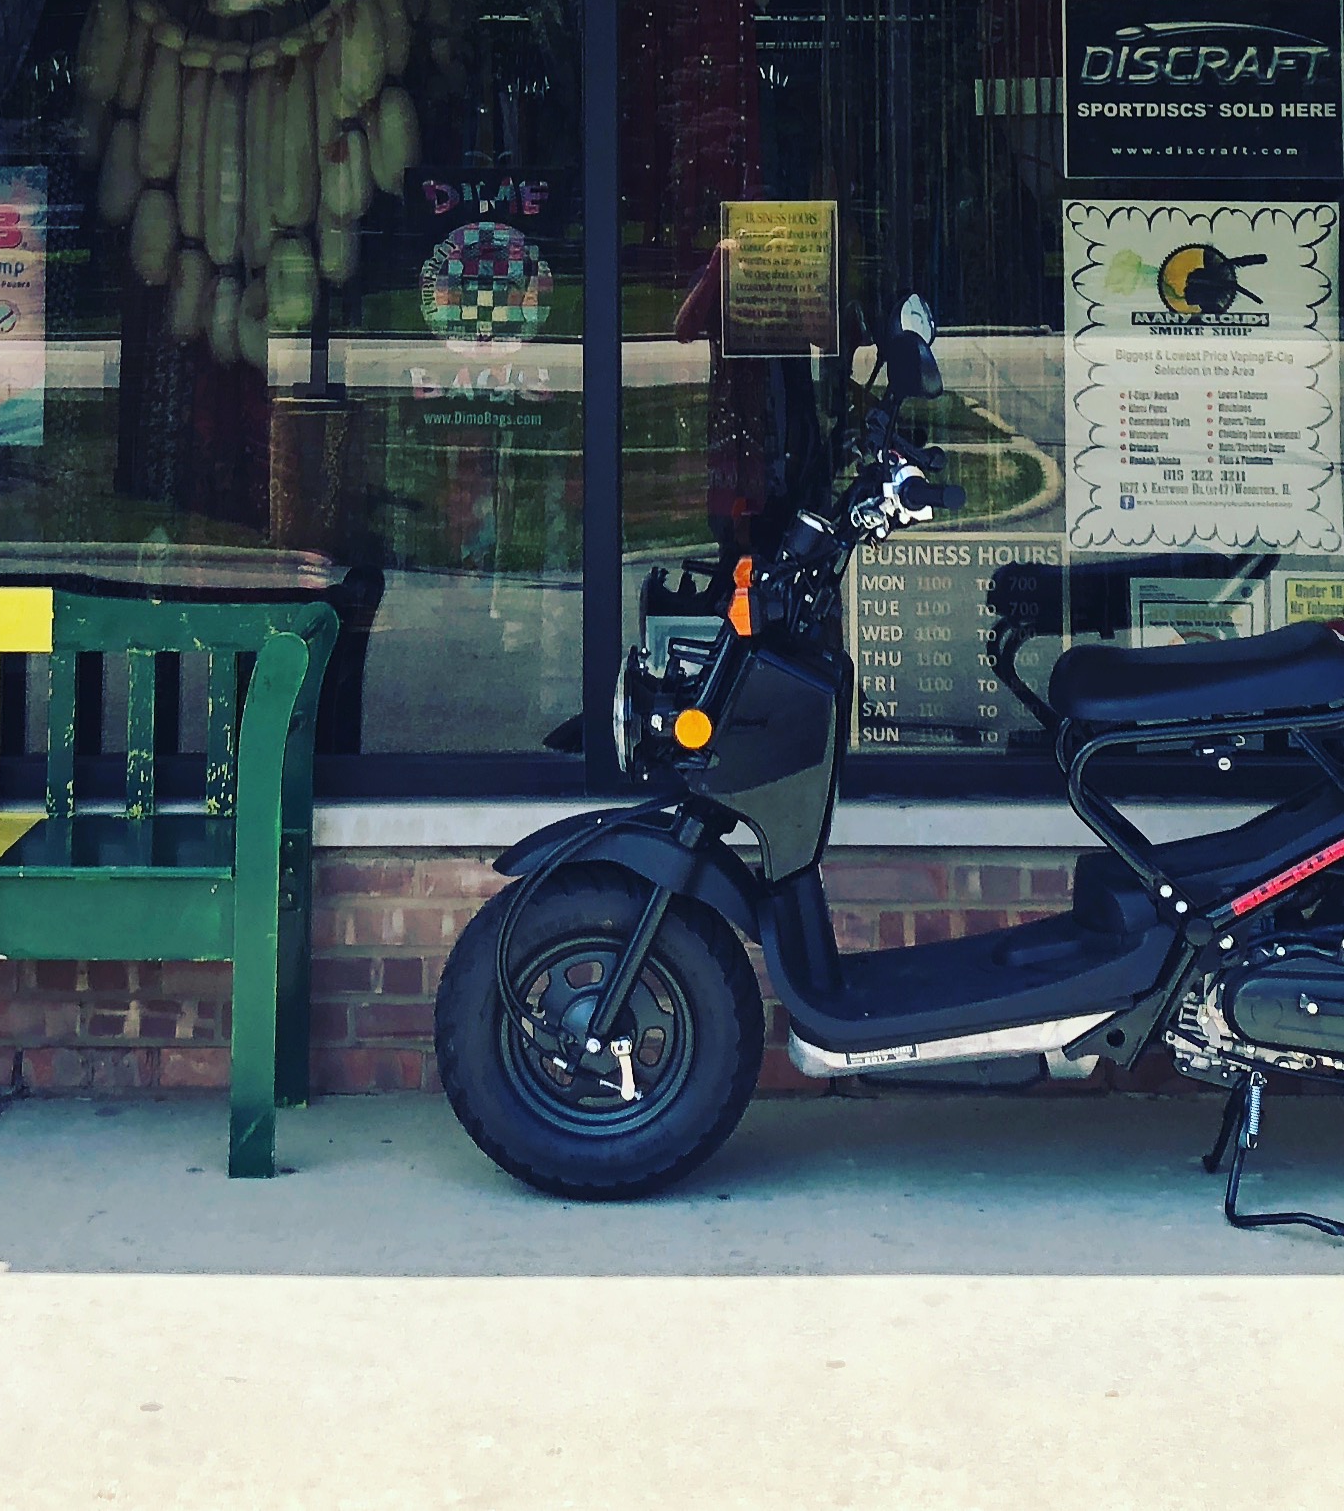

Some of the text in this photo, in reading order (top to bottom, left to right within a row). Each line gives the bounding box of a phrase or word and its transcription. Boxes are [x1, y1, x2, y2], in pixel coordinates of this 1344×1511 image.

[1080, 46, 1331, 85] DISCRAFT
[1219, 102, 1274, 118] SOLD
[1281, 103, 1337, 118] HERE
[1111, 146, 1298, 155] www.discraft.com
[422, 177, 549, 215] DIME
[1134, 314, 1269, 325] MANY CLOUDS
[1149, 326, 1253, 337] SMOKE SHOP
[1115, 349, 1154, 363] Biggest
[1165, 350, 1201, 362] Lowest
[1203, 350, 1229, 362] Price
[1154, 365, 1256, 377] Selection in the Area
[1191, 469, 1214, 482] 322
[1220, 470, 1246, 482] 3211
[861, 545, 1062, 566] BUSINESS HOURS
[862, 575, 905, 591] MON
[917, 577, 951, 591] 1100
[976, 578, 998, 592] TO
[1295, 583, 1327, 599] Under
[862, 600, 900, 616] TUE
[916, 602, 950, 616] 1100
[976, 603, 998, 617] TO
[1290, 600, 1305, 615] No
[862, 625, 904, 642] WED
[976, 628, 998, 643] TO
[862, 650, 902, 667] THU
[976, 653, 998, 668] TO
[862, 676, 896, 692] FRI
[976, 679, 998, 693] TO
[862, 701, 998, 718] SAT TO
[862, 727, 900, 742] SUN
[976, 730, 998, 743] TO
